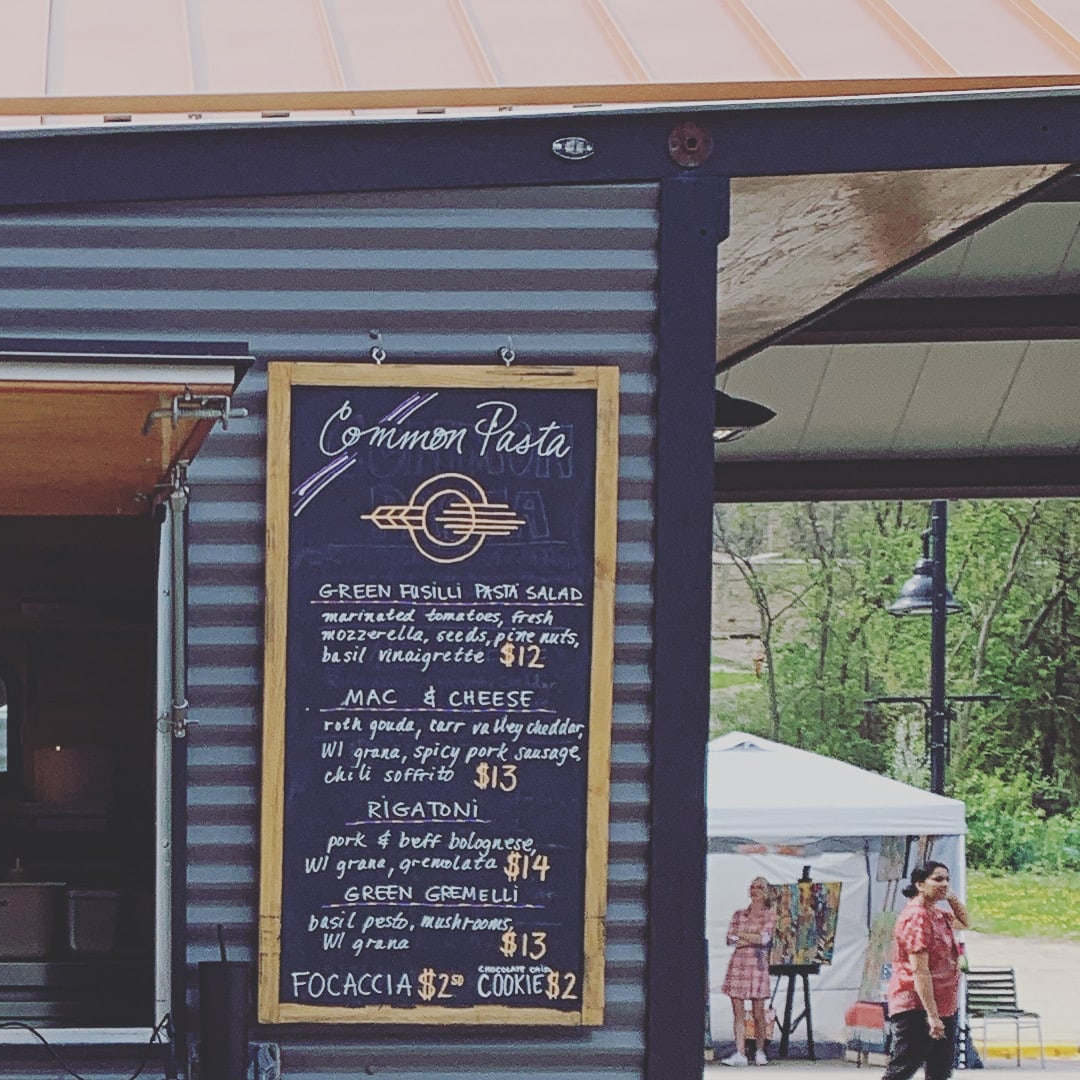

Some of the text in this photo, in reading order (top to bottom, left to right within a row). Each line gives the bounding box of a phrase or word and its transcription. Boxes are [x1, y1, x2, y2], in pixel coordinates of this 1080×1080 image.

[319, 400, 467, 456] Common
[475, 400, 571, 457] Pasta
[319, 584, 391, 599] GREEN
[475, 583, 520, 600] PASTA
[526, 586, 583, 600] SALAD
[321, 608, 553, 628] marinated tomatoes, fresh
[321, 625, 580, 648] mozzerella, seeds, pine nuts,
[321, 642, 545, 672] basil vinaigrette $12
[340, 685, 534, 708] MAC & CHEESE
[324, 714, 585, 742] roth gouda, carr valley cheddar,
[350, 747, 408, 769] grana,
[413, 742, 460, 768] spicy
[465, 742, 509, 764] pork
[324, 761, 518, 792] chili soffrito $13
[326, 831, 367, 854] pork
[448, 831, 537, 857] bolognese,
[336, 858, 395, 879] grana,
[399, 854, 498, 875] gremolata
[504, 851, 551, 882] $14
[344, 885, 413, 901] GREEN
[307, 910, 357, 932] basil
[361, 911, 415, 934] pesto,
[351, 938, 410, 957] grana
[499, 928, 547, 960] $13
[291, 971, 412, 998] FOCACCIA
[477, 970, 579, 1000] COOKIE $2
